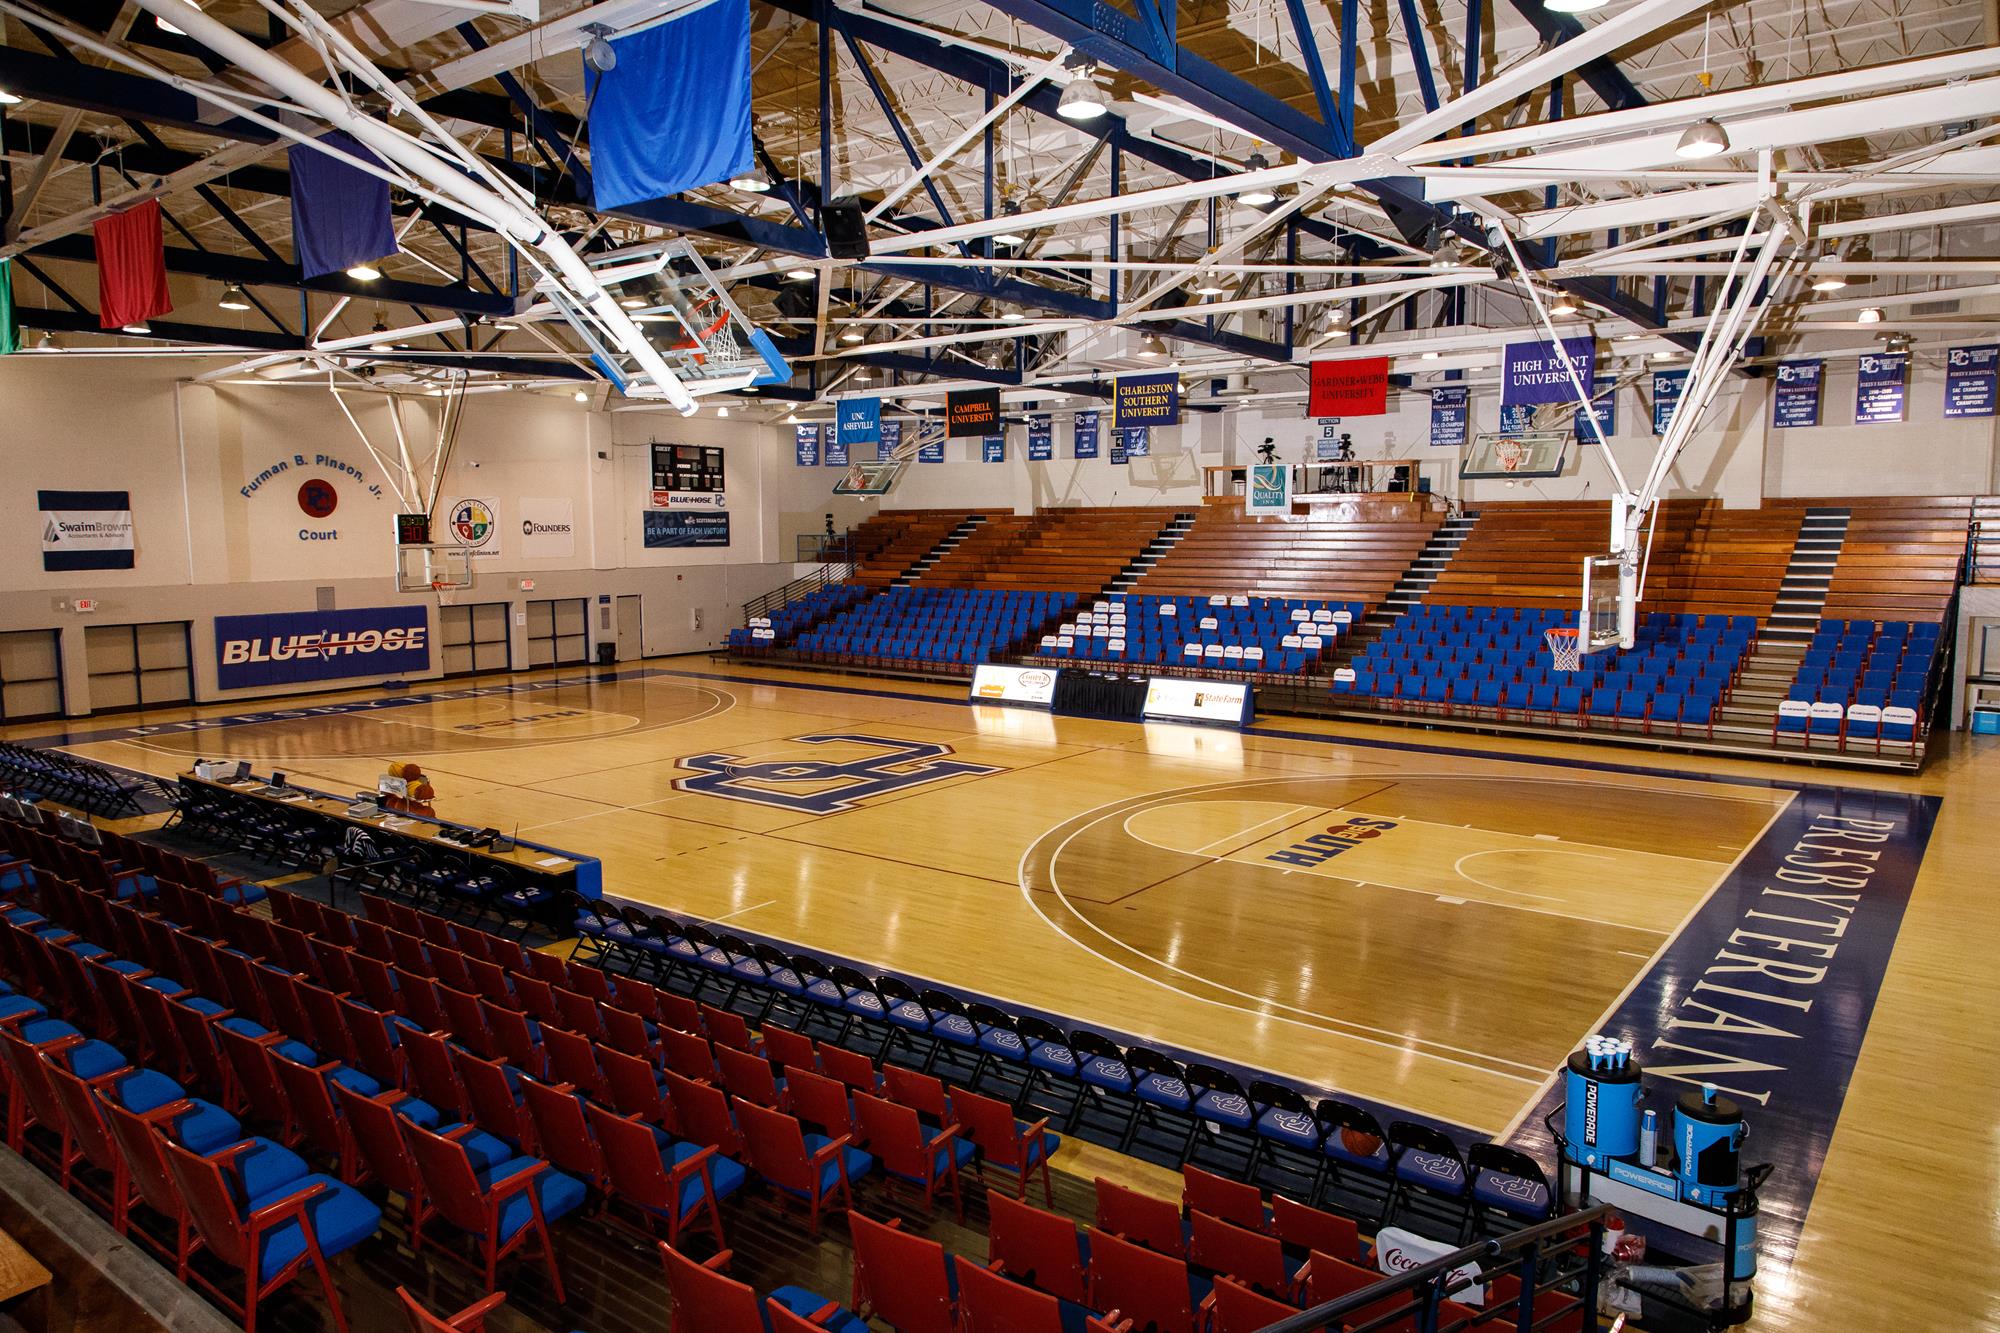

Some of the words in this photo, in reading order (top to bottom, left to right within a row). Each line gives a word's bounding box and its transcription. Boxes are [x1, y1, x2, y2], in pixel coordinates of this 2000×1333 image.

[1513, 360, 1542, 373] HIGH
[1120, 384, 1173, 396] CHARLESTON
[1322, 388, 1374, 400] UNIVERSITY
[1124, 395, 1168, 406] SOUTHERN
[954, 402, 991, 413] CAMPBELL
[1122, 406, 1170, 418] UNIVERSITY
[851, 412, 864, 420] UNC
[952, 413, 994, 424] UNIVERSITY
[843, 421, 874, 431] ASHEVILLE
[1326, 428, 1332, 436] 5
[1117, 438, 1122, 446] 4
[240, 461, 288, 498] Furman
[294, 455, 308, 466] B.
[316, 454, 364, 483] Pinson,
[369, 484, 382, 500] Jr.
[1254, 491, 1283, 500] QUALITY
[299, 530, 338, 540] Court
[222, 634, 322, 664] BLUE
[328, 627, 426, 656] HOSE
[1641, 813, 1896, 1106] PRESBYTERIAN
[1586, 1084, 1597, 1144] POWERADE
[1685, 1124, 1694, 1177] POWERADE
[1614, 1167, 1674, 1192] POWERADE
